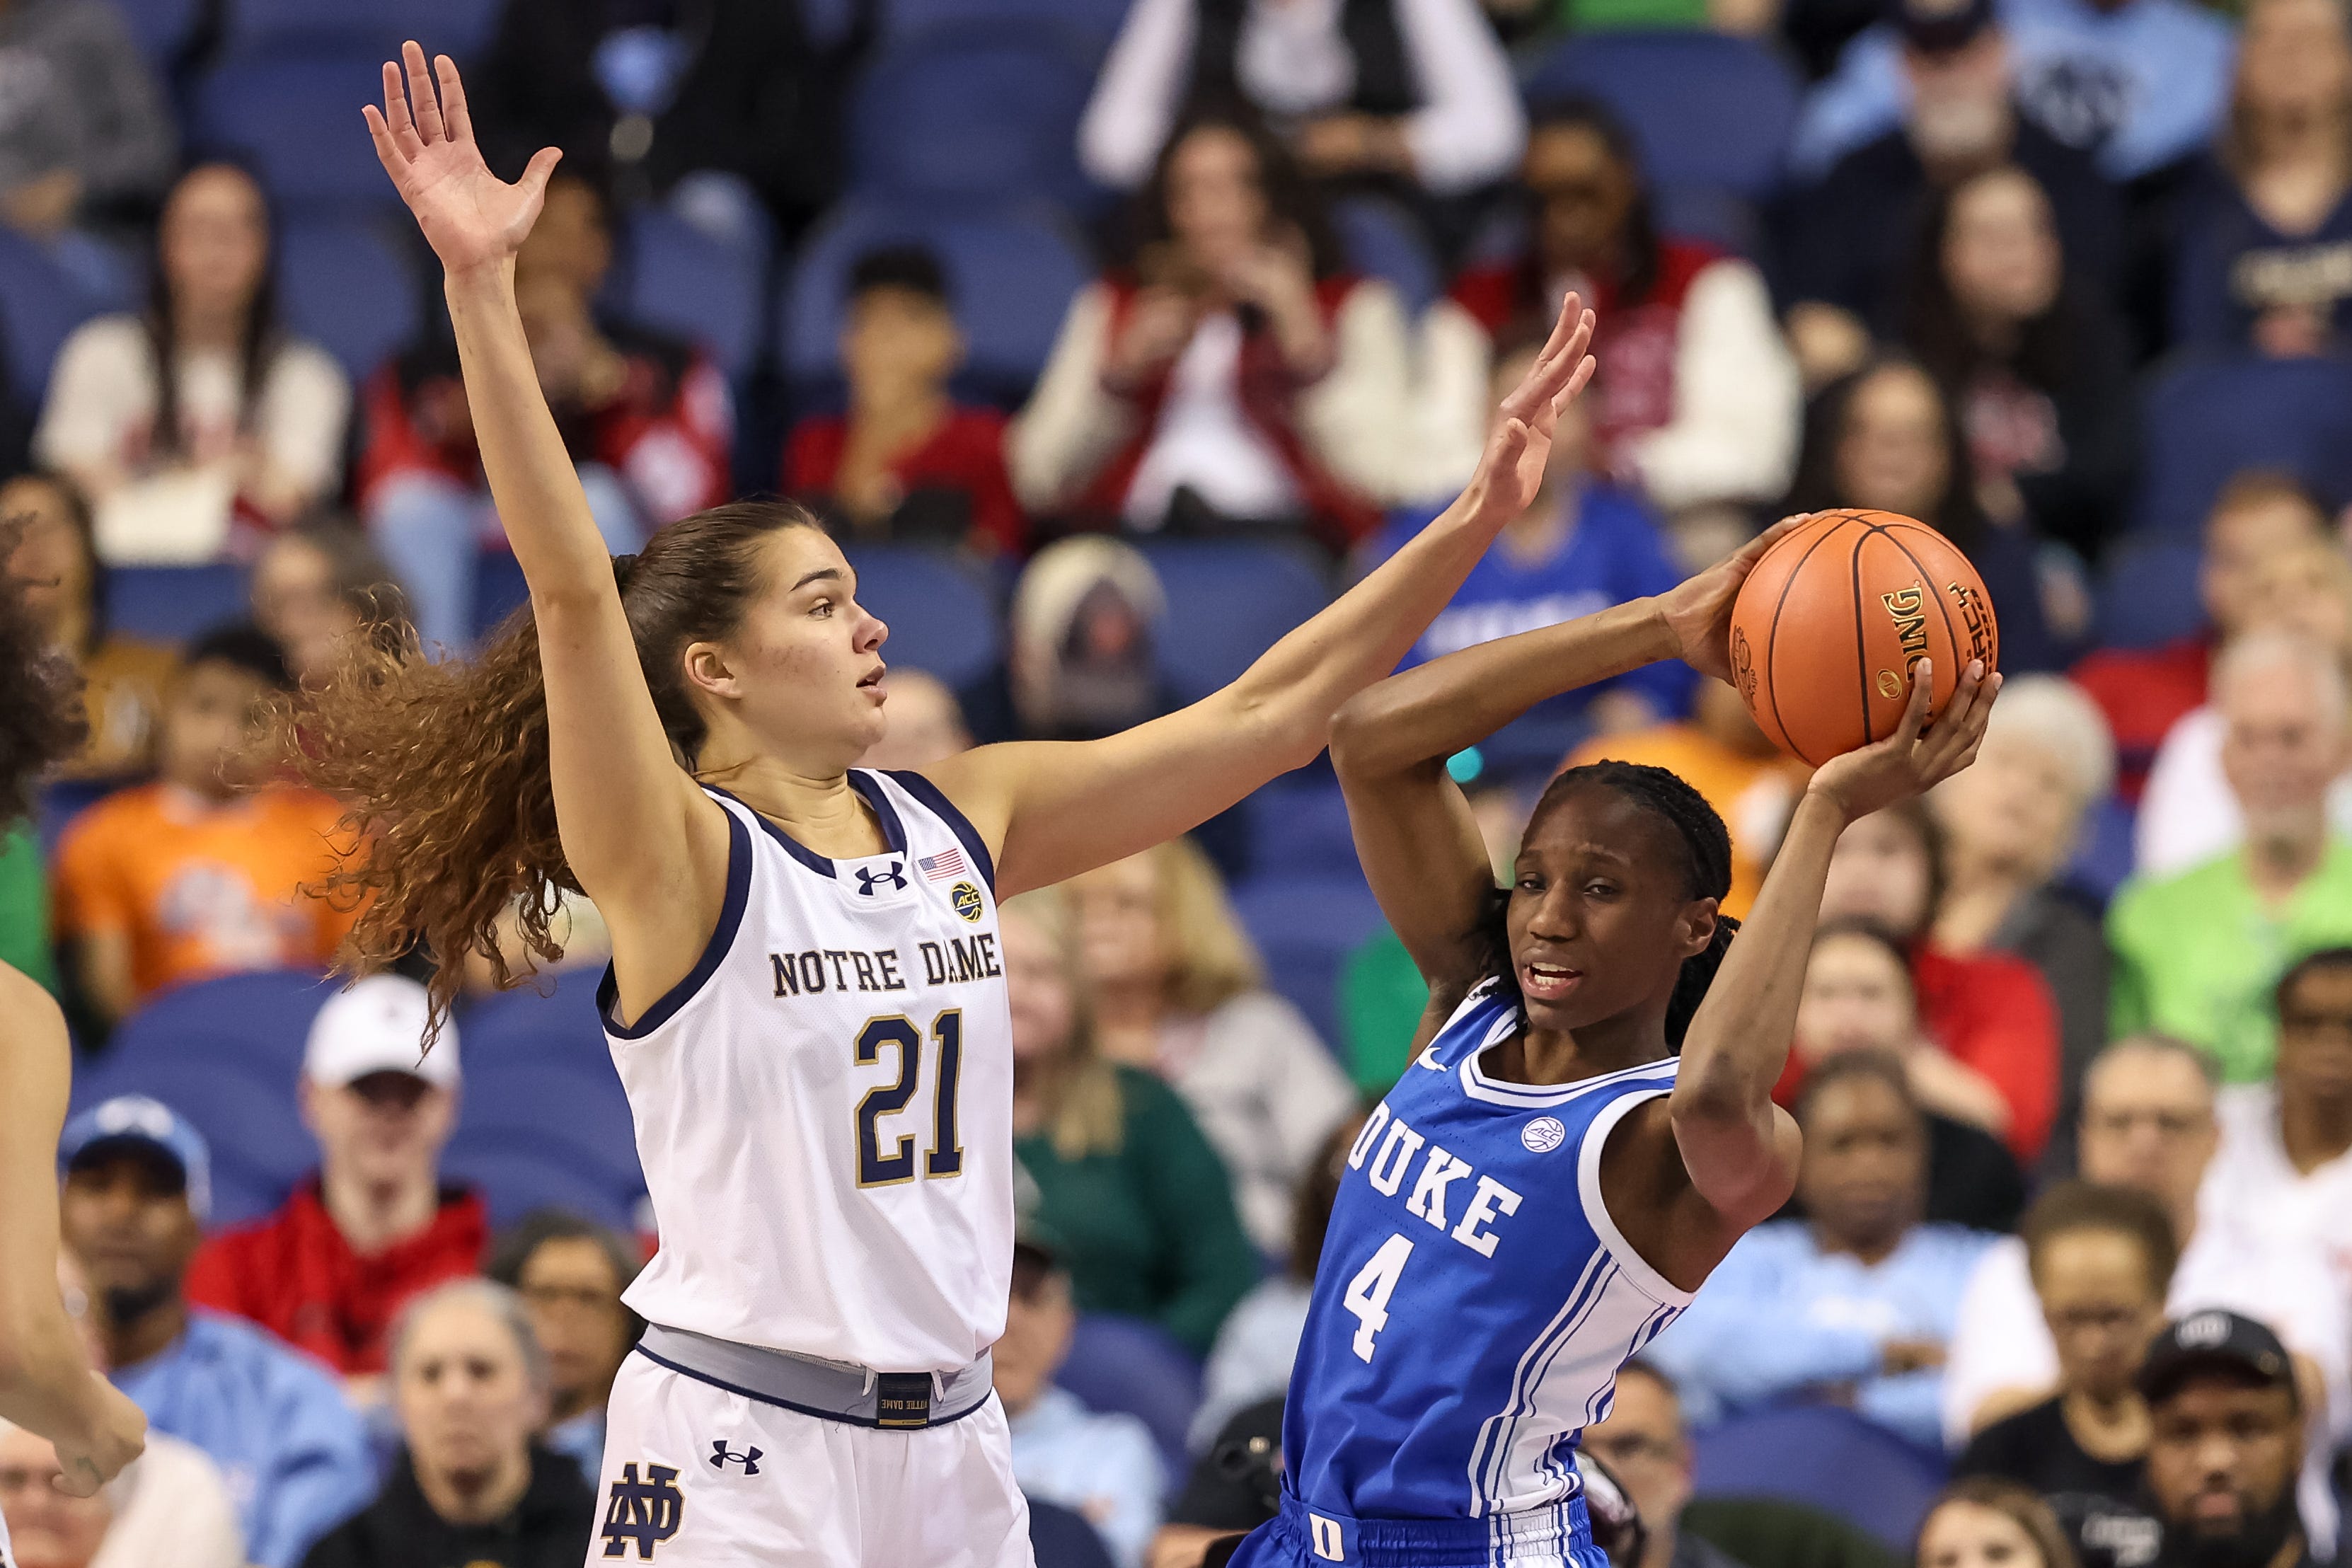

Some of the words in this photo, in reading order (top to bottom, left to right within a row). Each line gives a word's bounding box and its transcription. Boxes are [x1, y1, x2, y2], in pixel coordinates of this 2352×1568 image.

[957, 891, 980, 908] ACC
[769, 947, 906, 999] NOTRE
[918, 932, 1002, 986] DAME
[853, 1008, 964, 1189] 21
[1530, 1127, 1562, 1141] ACC
[1347, 1099, 1524, 1259] DUKE
[1342, 1232, 1415, 1364] 4
[880, 1399, 903, 1410] DAME
[1308, 1512, 1345, 1562] D
